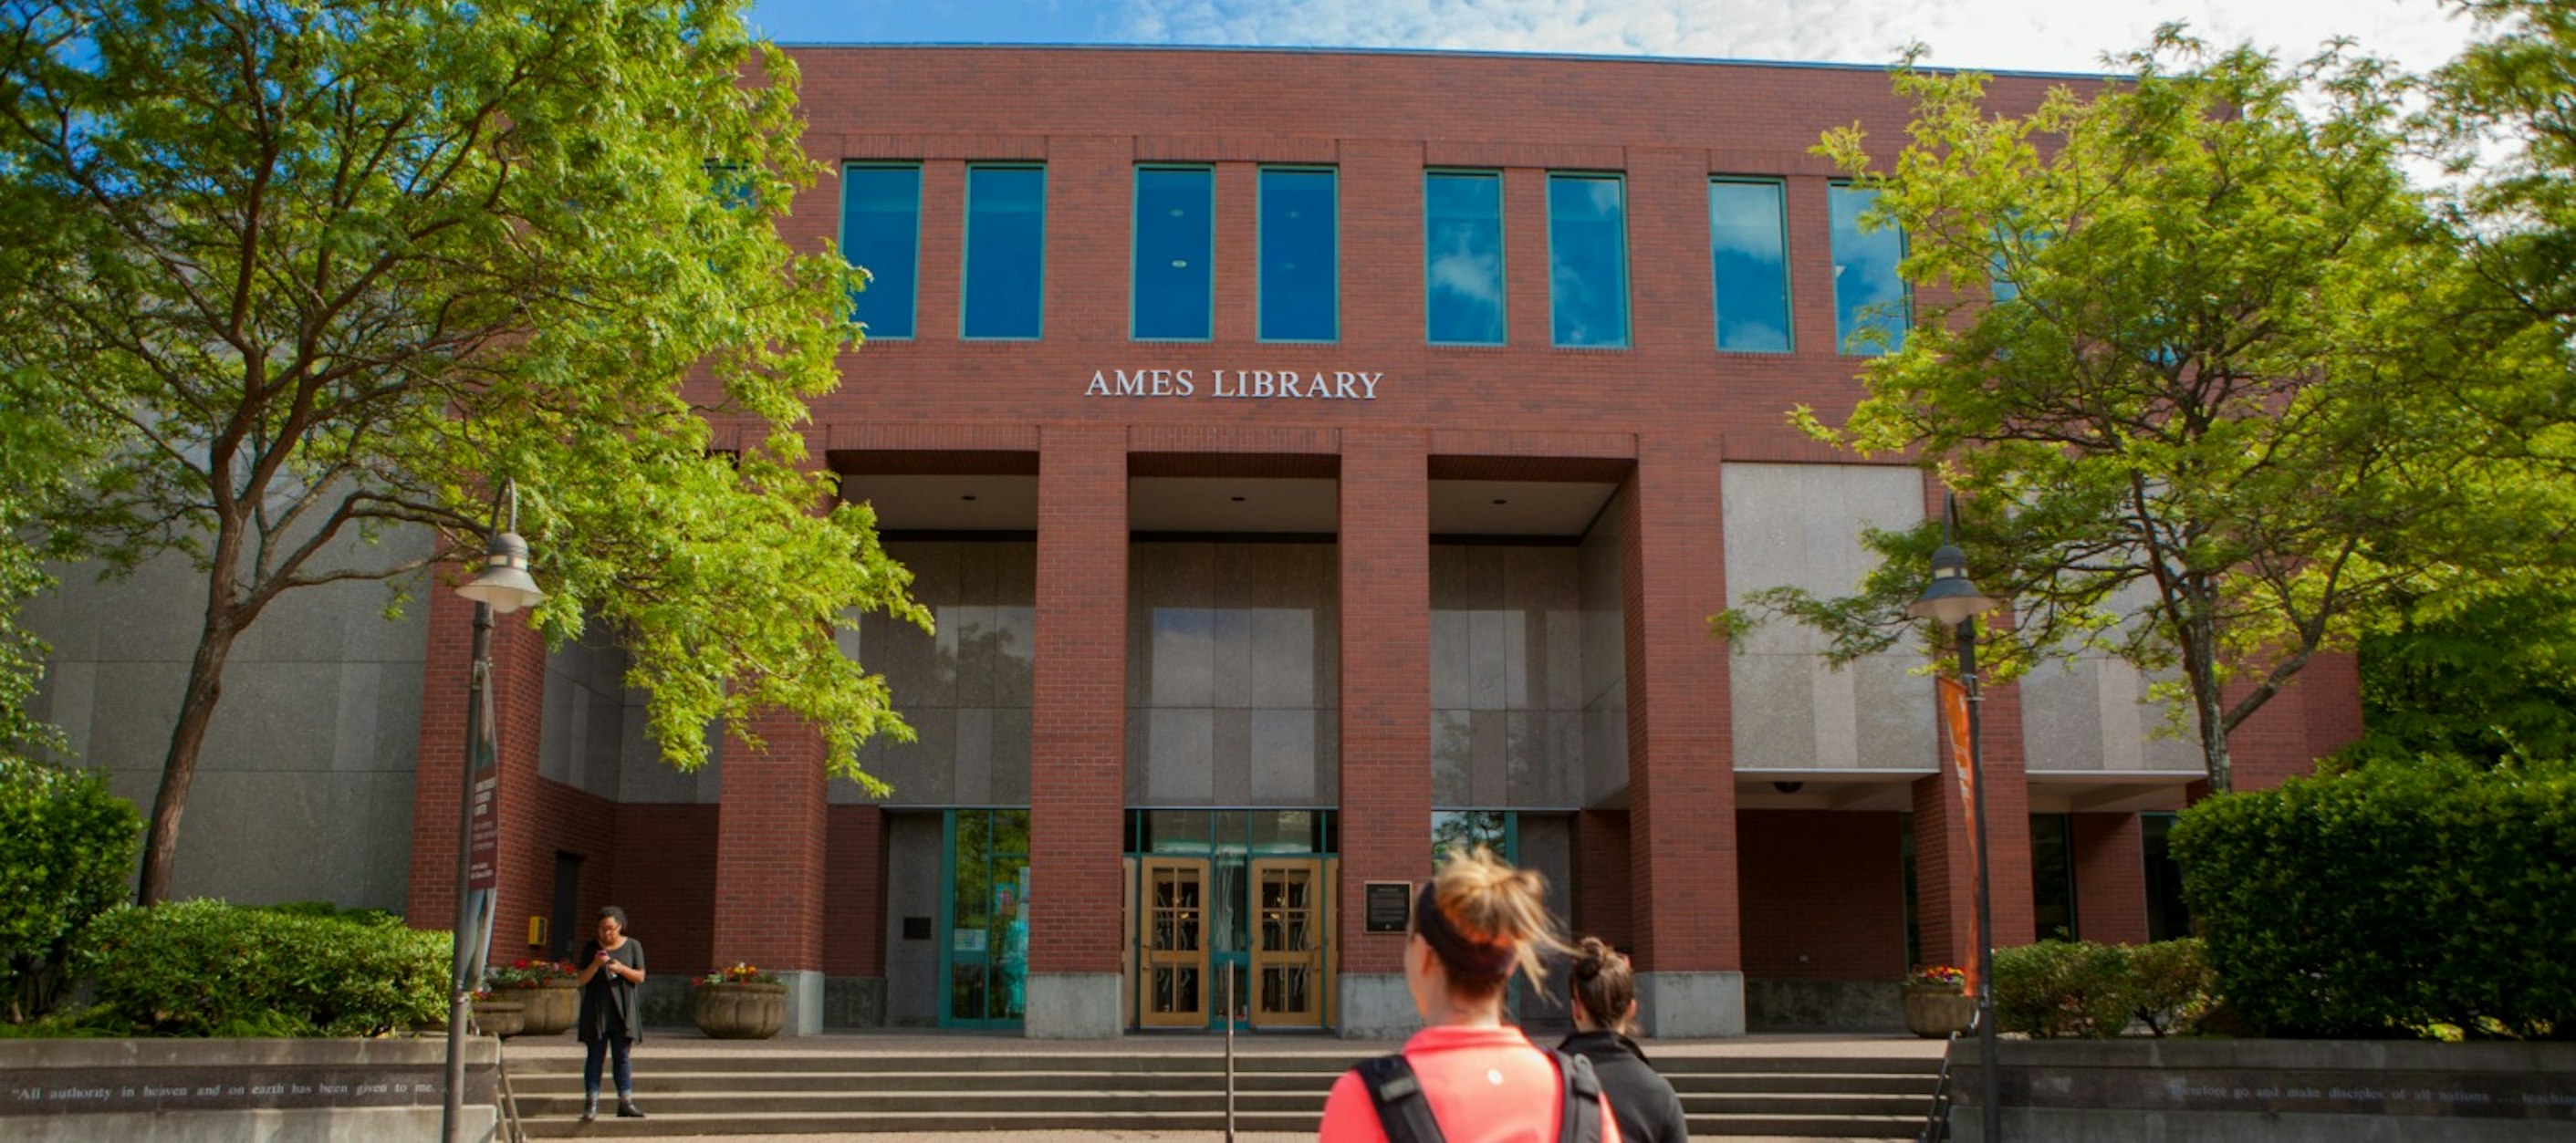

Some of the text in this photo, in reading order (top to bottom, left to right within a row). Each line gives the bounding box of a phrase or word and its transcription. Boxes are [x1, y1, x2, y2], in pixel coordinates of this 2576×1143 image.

[1085, 369, 1383, 399] AMES LIBRARY
[49, 1087, 112, 1101] authority
[120, 1086, 135, 1097] in
[143, 1086, 187, 1096] heaven
[196, 1085, 221, 1096] and
[228, 1086, 245, 1095] on
[252, 1083, 285, 1095] earth
[292, 1084, 312, 1094] has
[319, 1084, 348, 1094] been
[357, 1084, 388, 1096] given
[395, 1083, 408, 1093] to
[2234, 1086, 2251, 1099] go
[2391, 1086, 2407, 1099] of
